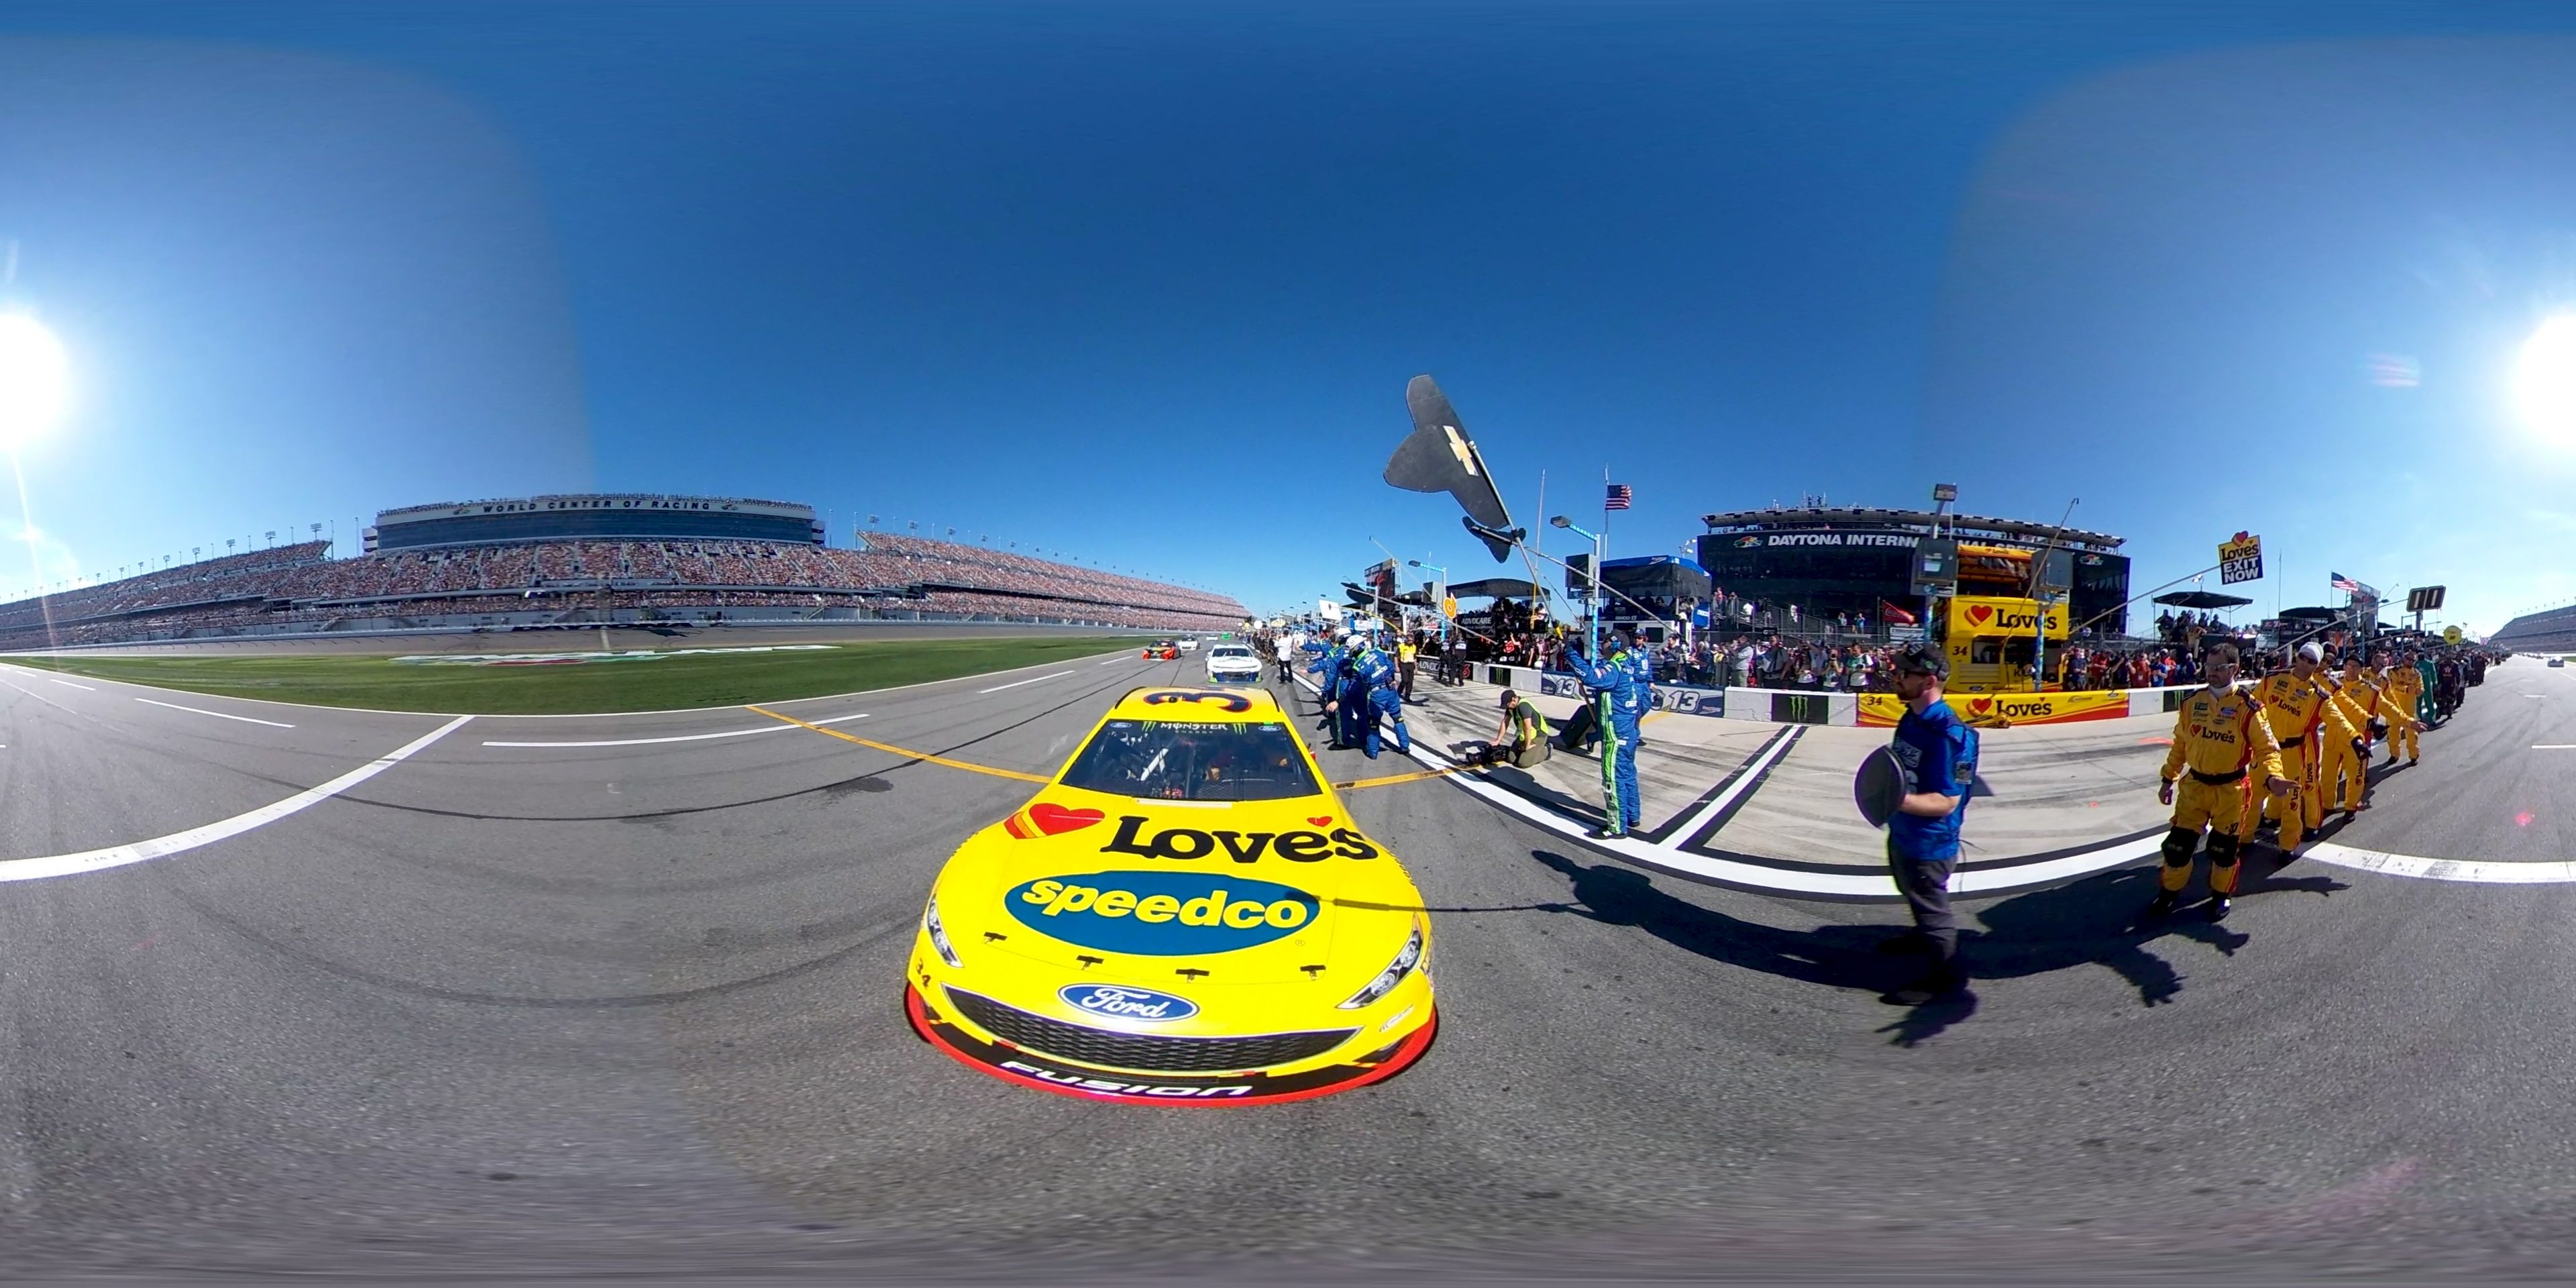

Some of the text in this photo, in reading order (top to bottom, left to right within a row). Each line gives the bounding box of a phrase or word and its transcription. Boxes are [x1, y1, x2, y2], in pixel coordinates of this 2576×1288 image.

[482, 500, 711, 513] WORLD CENTER OF RACING
[1768, 534, 1842, 545] DAYTONA
[2222, 557, 2259, 574] EXIT
[2224, 567, 2259, 584] NOW
[1952, 645, 1968, 656] 34
[1556, 678, 1576, 696] 13
[1668, 690, 1701, 714] 13
[1866, 696, 1883, 706] 34
[1160, 722, 1228, 731] MONSTER
[1099, 815, 1379, 863] Love's
[1022, 879, 1308, 929] speedco
[915, 957, 930, 988] 34
[1081, 987, 1171, 1018] Ford
[999, 1061, 1252, 1097] FUSION
